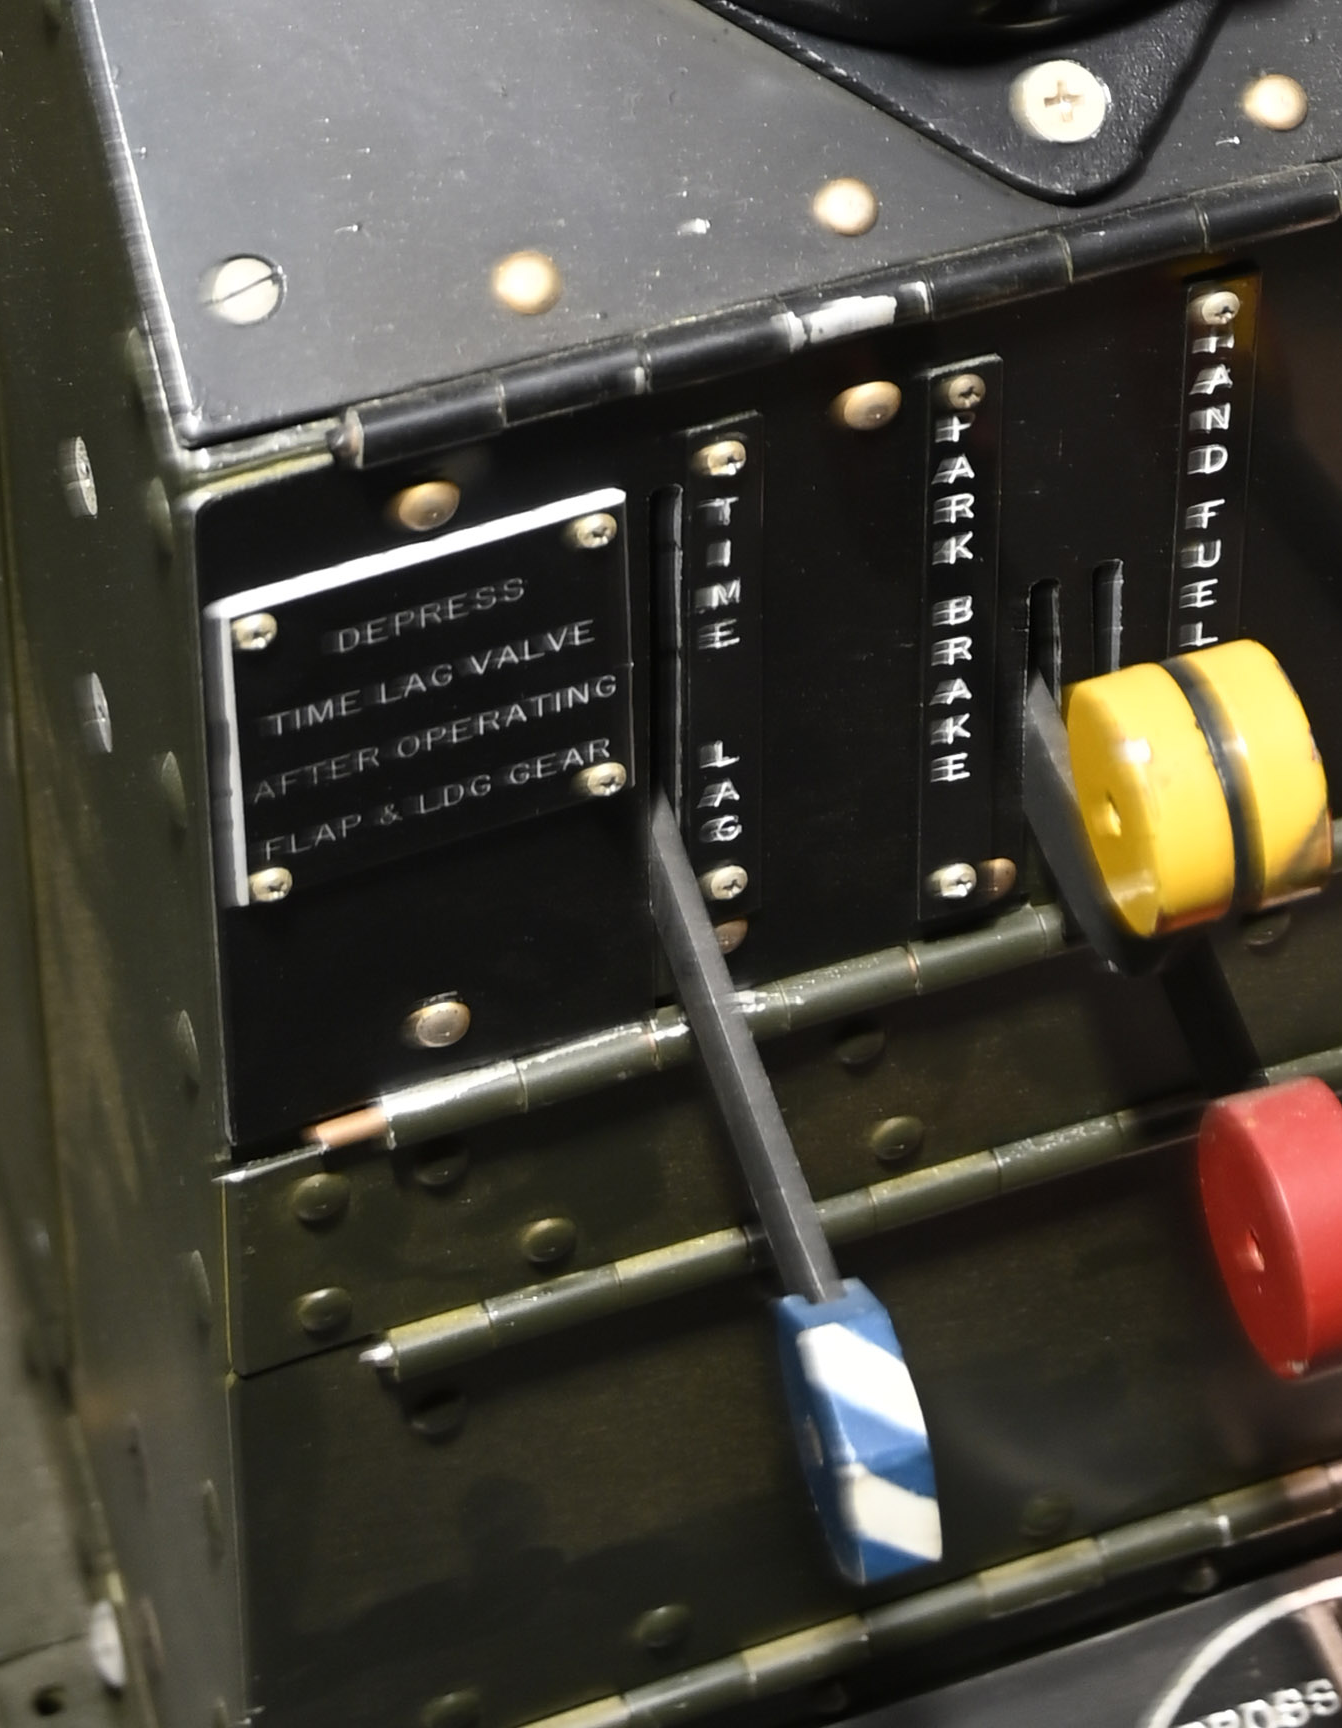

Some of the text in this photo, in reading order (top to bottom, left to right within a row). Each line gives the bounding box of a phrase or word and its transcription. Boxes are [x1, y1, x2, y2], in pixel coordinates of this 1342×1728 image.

[336, 577, 526, 654] DEPRESS
[1179, 499, 1225, 647] FUEL
[267, 619, 596, 737] TIME LAG VALVE
[699, 497, 743, 842] TIME LAG
[930, 595, 973, 783] BRAKE
[254, 673, 618, 805] AFTER OPERATING
[262, 738, 611, 862] FLAP & LDG GEAR
